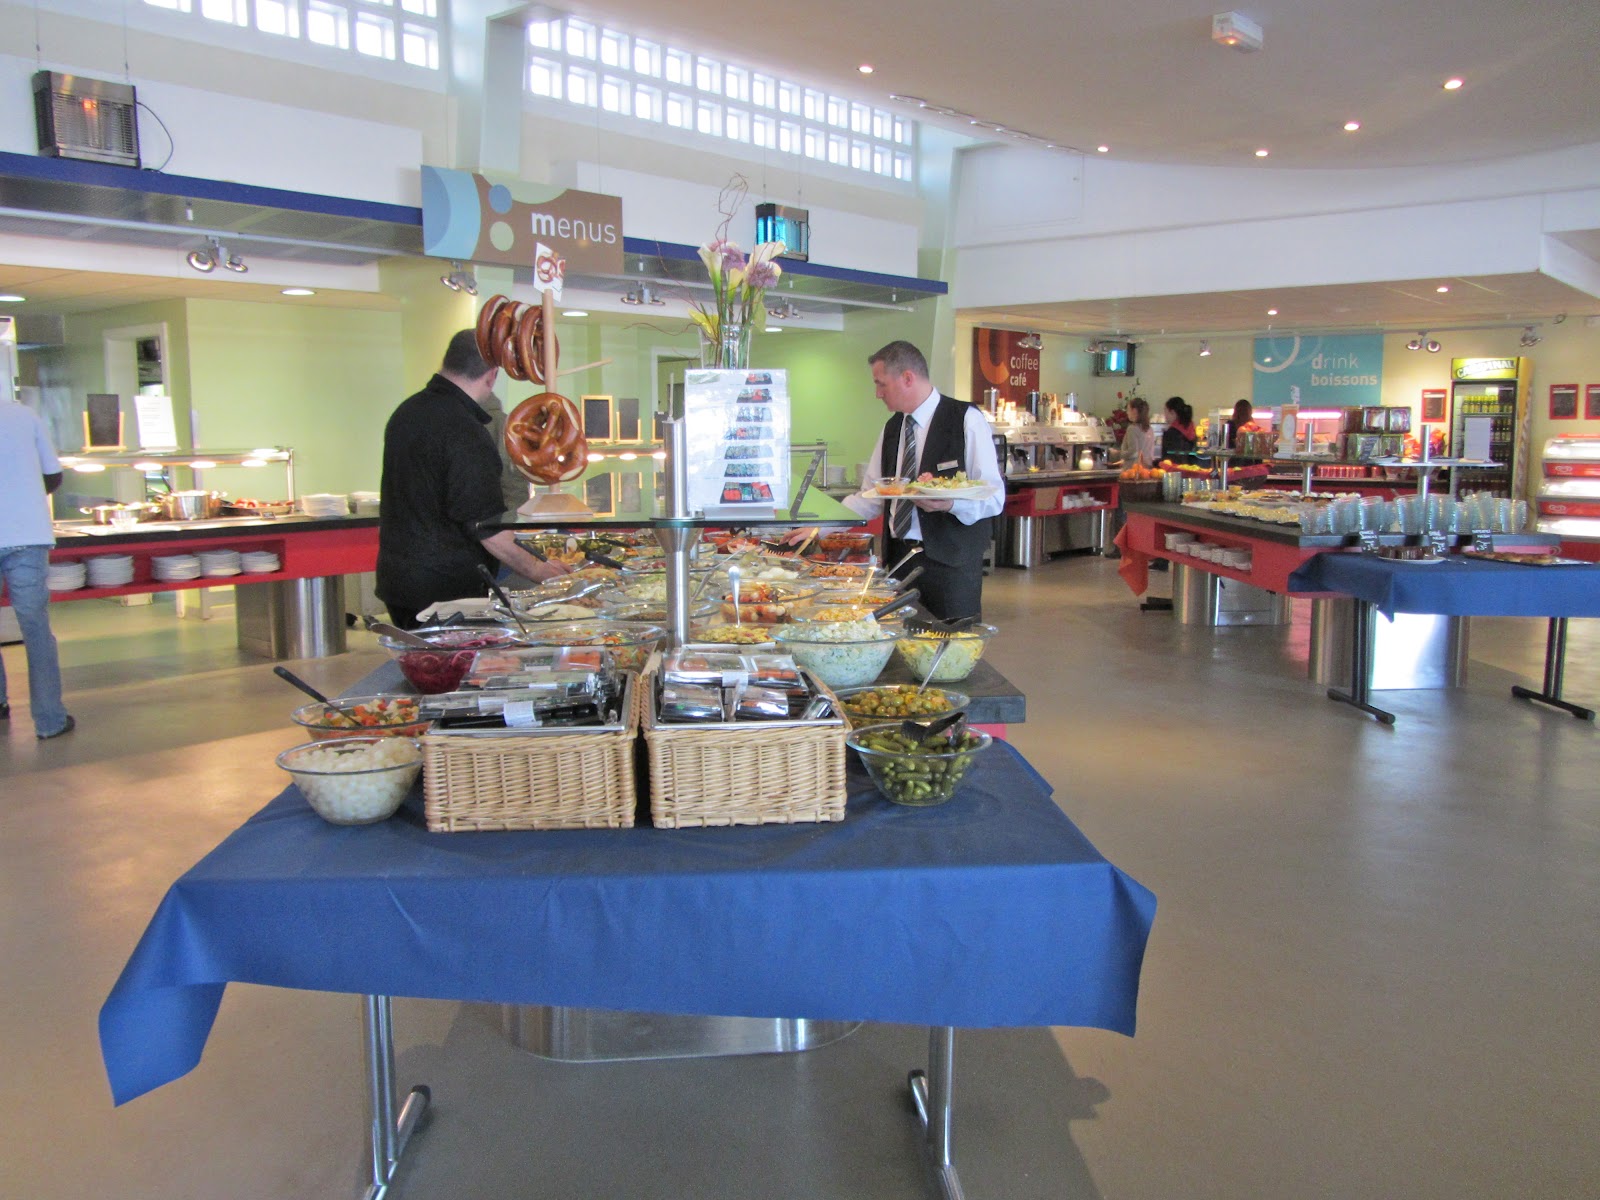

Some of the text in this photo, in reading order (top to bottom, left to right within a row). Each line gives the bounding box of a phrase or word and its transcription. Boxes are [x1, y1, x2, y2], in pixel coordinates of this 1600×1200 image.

[531, 212, 616, 244] menus
[1010, 353, 1039, 370] coffee
[1311, 353, 1359, 369] drink
[1010, 372, 1027, 386] café
[1311, 373, 1378, 386] boissons
